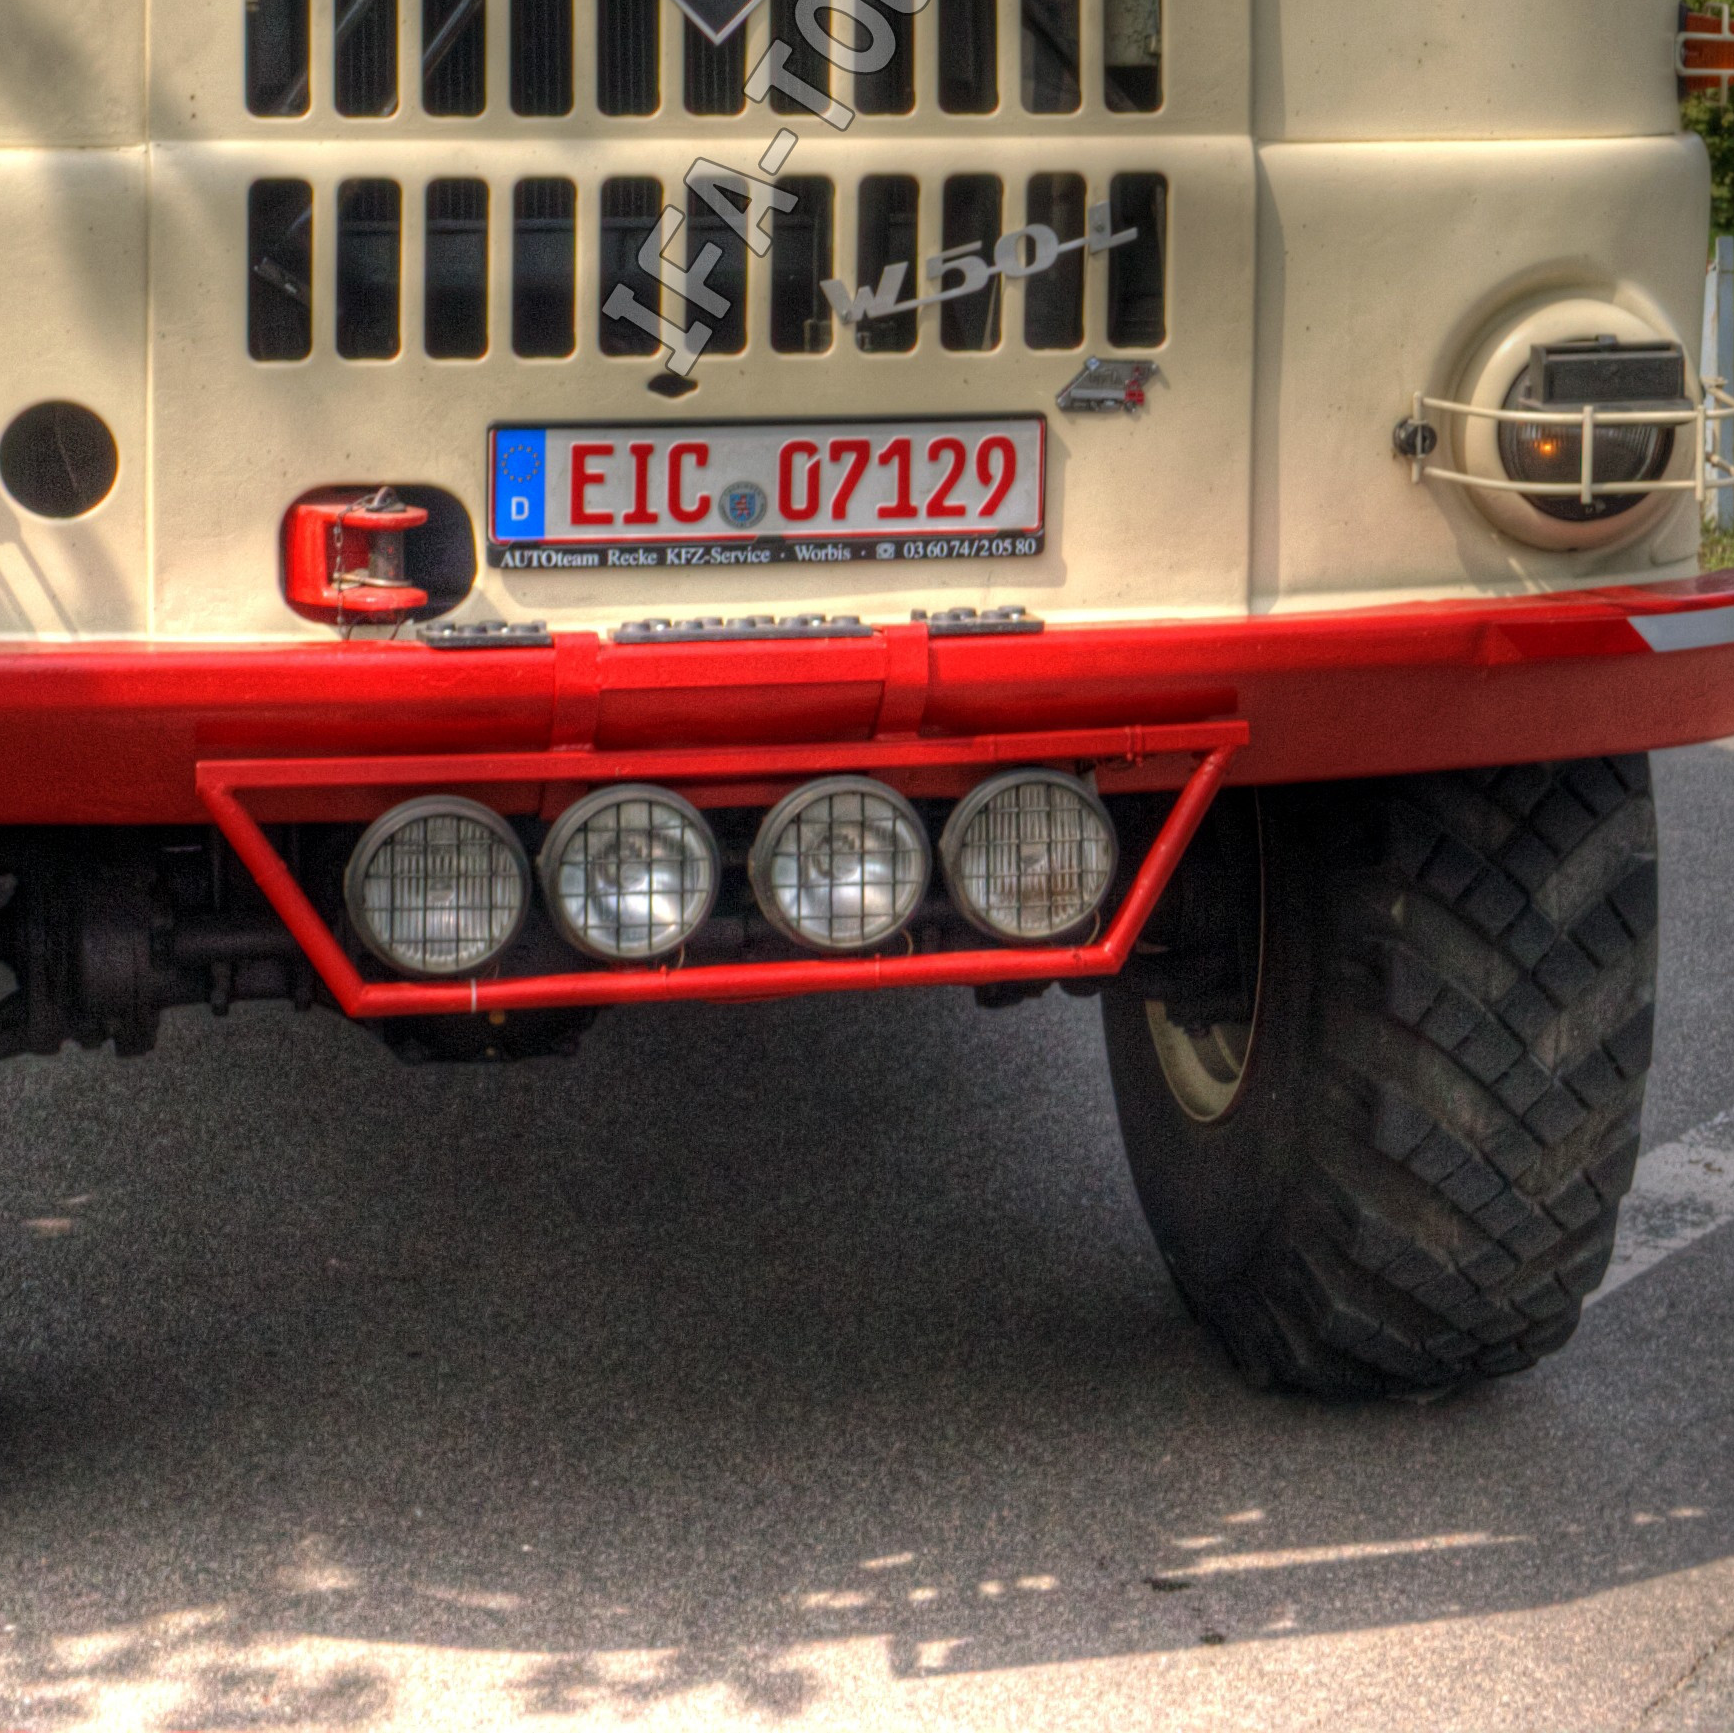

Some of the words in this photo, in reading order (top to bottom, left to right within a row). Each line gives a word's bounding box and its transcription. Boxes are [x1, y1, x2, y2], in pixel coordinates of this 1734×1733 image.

[569, 443, 711, 526] EIC
[777, 435, 1018, 521] 07129
[511, 496, 530, 521] D
[500, 549, 600, 568] AUTOteam
[607, 547, 658, 566] Recke
[666, 546, 771, 565] KFZ-Service
[794, 543, 852, 561] Worbis
